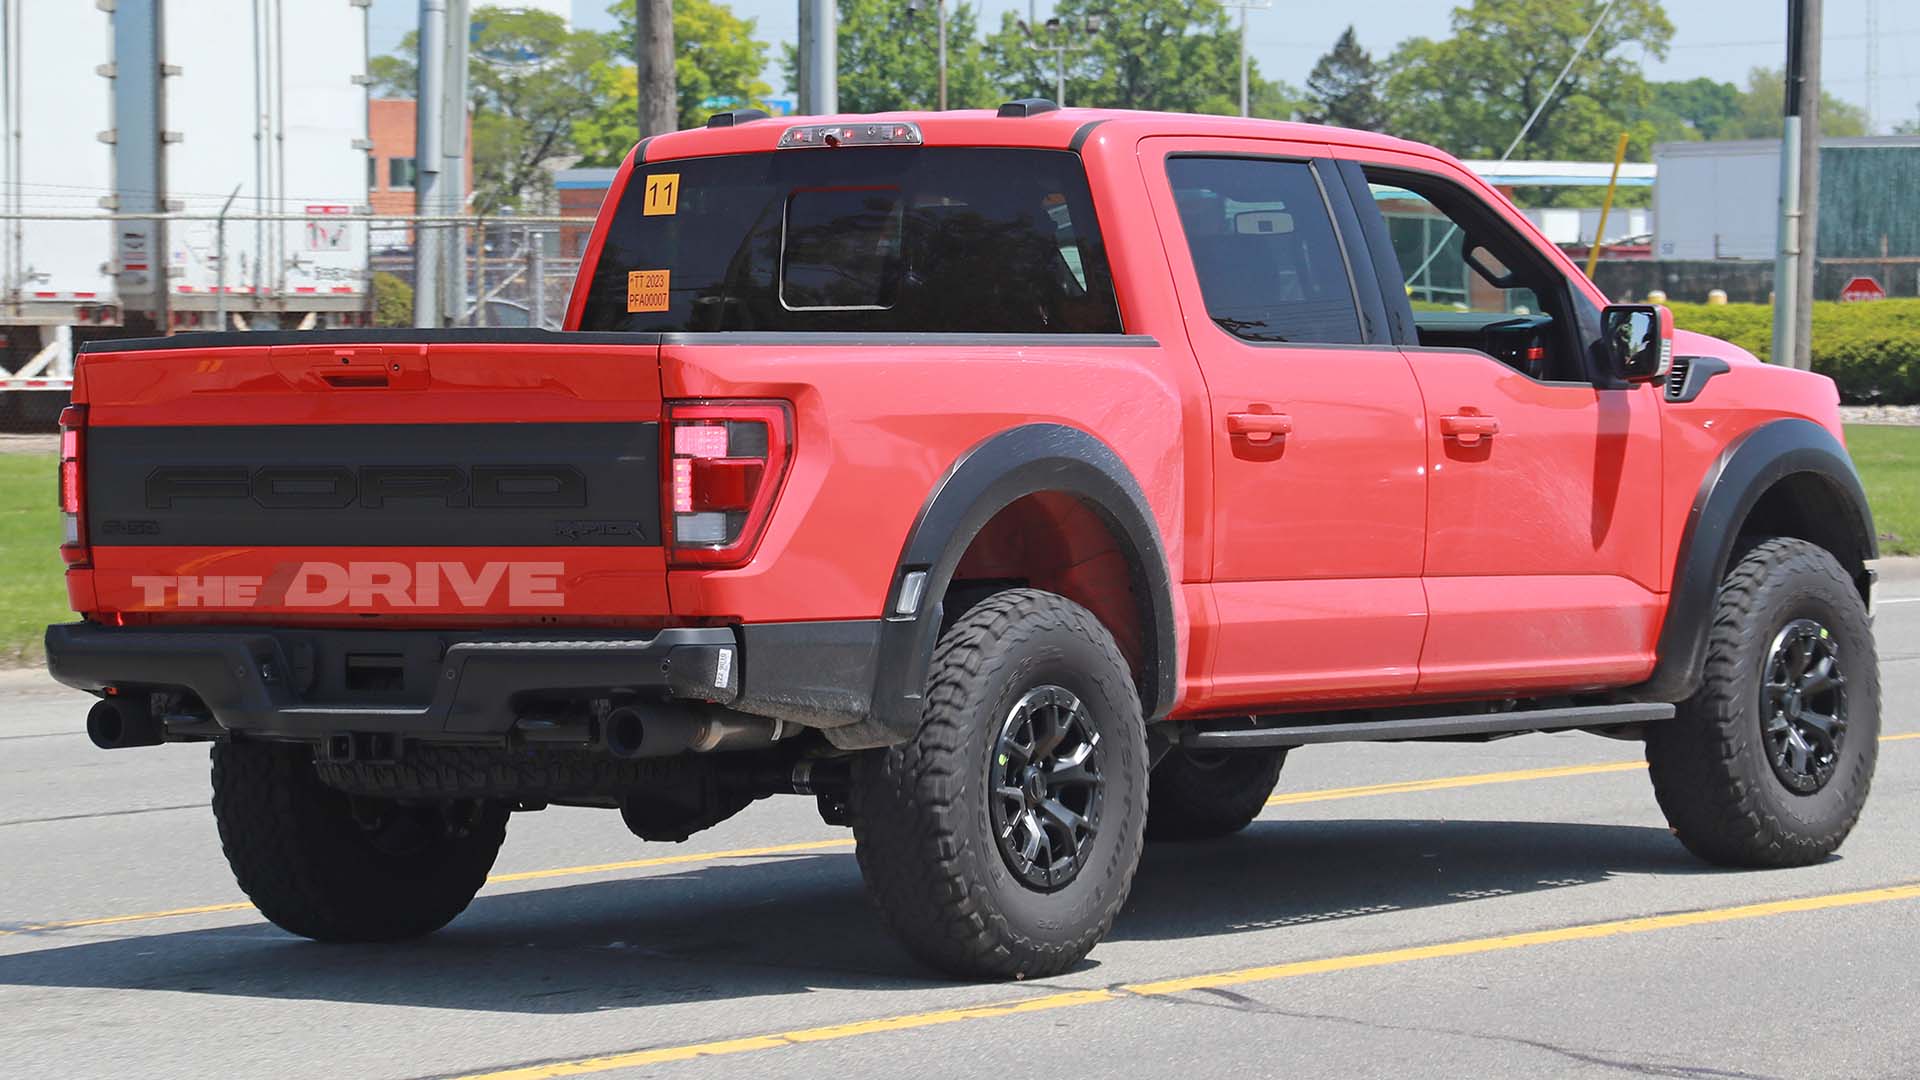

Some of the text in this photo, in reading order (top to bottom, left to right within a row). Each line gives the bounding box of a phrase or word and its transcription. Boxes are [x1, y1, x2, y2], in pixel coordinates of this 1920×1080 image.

[649, 181, 673, 207] 11
[646, 274, 664, 288] 2023
[629, 292, 668, 307] PFA00007
[145, 465, 588, 509] FORD
